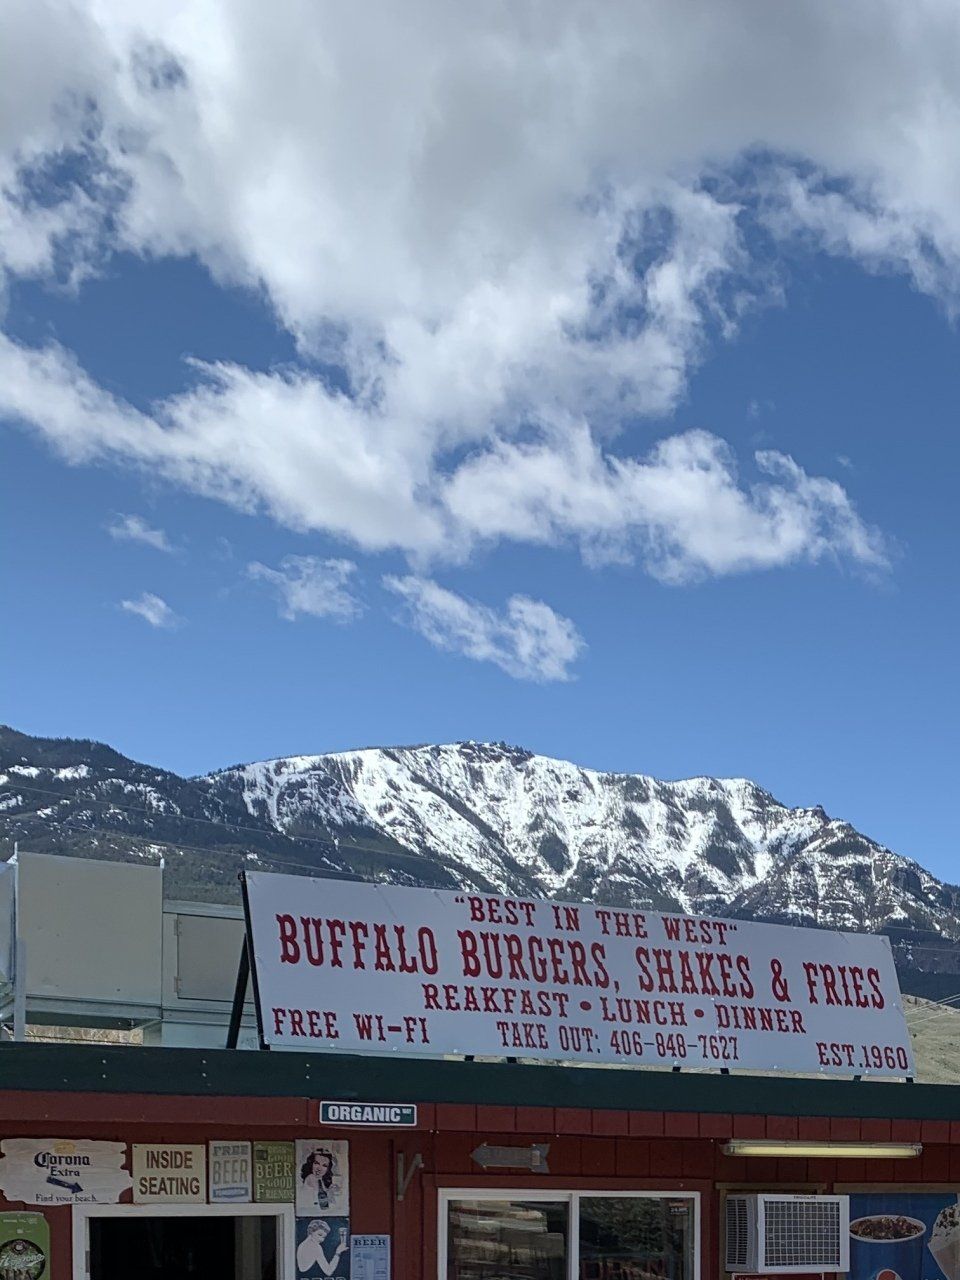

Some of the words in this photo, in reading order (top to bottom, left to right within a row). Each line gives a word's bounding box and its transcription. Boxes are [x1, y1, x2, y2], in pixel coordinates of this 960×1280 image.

[551, 904, 580, 931] IN
[595, 910, 648, 939] THE
[275, 913, 439, 975] BUFFALO
[457, 929, 620, 995] BURGERS,
[635, 946, 755, 1000] SHAKES
[771, 958, 792, 1003] &
[802, 961, 885, 1011] FRIES
[421, 983, 569, 1018] REAKFAST
[600, 996, 688, 1027] LUNCH
[714, 1004, 807, 1034] DINNER
[272, 1007, 339, 1040] FREE
[353, 1013, 431, 1044] WI-FI
[496, 1020, 549, 1050] TAKE
[559, 1025, 601, 1054] OUT:
[609, 1030, 740, 1061] 406-848-7627
[327, 1105, 401, 1122] ORGANIC
[34, 1151, 92, 1169] Corona
[146, 1150, 193, 1169] INSIDE
[213, 1145, 249, 1157] FREE
[50, 1166, 81, 1177] Extra
[212, 1159, 248, 1184] BEER
[256, 1162, 293, 1178] BEER
[139, 1176, 200, 1195] SEATING
[35, 1193, 53, 1202] Find
[55, 1195, 73, 1203] your
[353, 1238, 386, 1246] BEER
